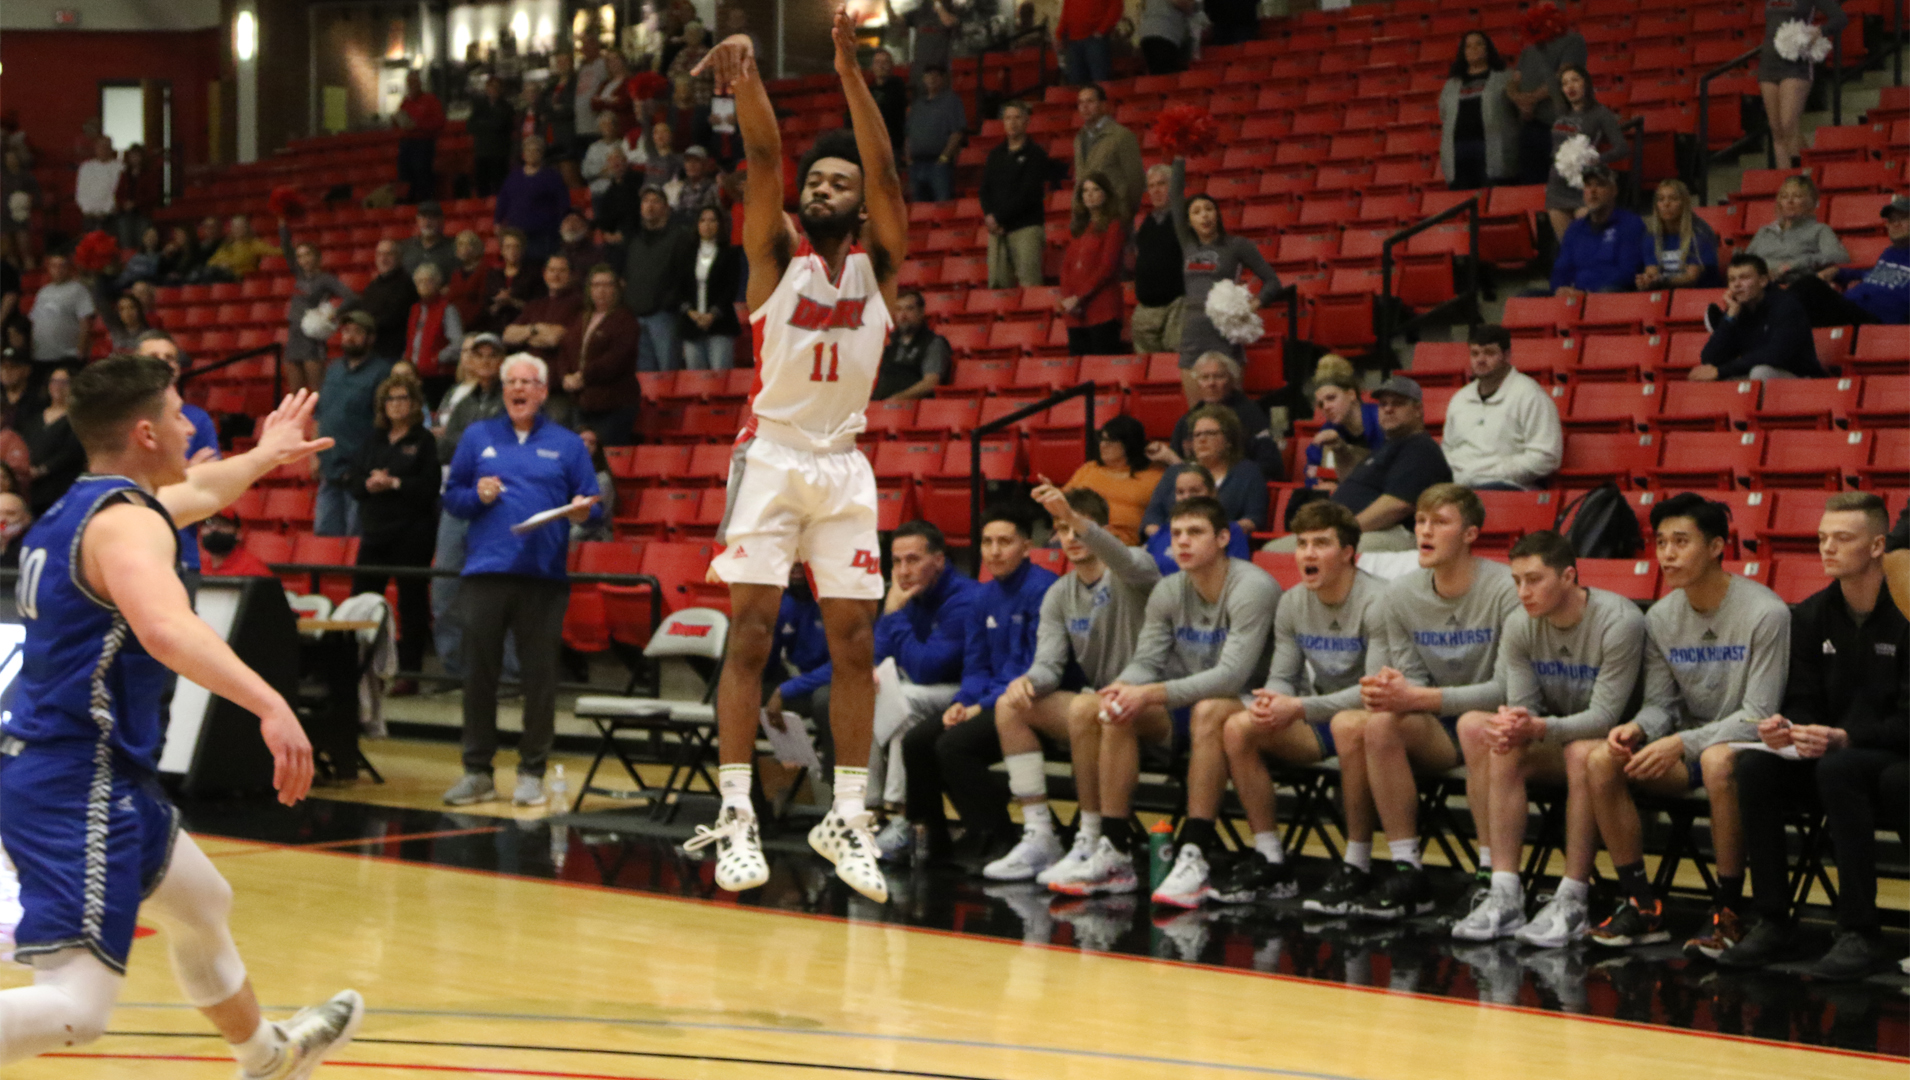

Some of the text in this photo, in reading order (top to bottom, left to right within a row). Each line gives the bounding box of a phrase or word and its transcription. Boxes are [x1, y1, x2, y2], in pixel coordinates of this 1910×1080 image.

[809, 341, 839, 381] 11
[850, 548, 880, 574] DU
[1414, 628, 1492, 646] ROCKHURST
[1668, 645, 1746, 663] ROCKHURST
